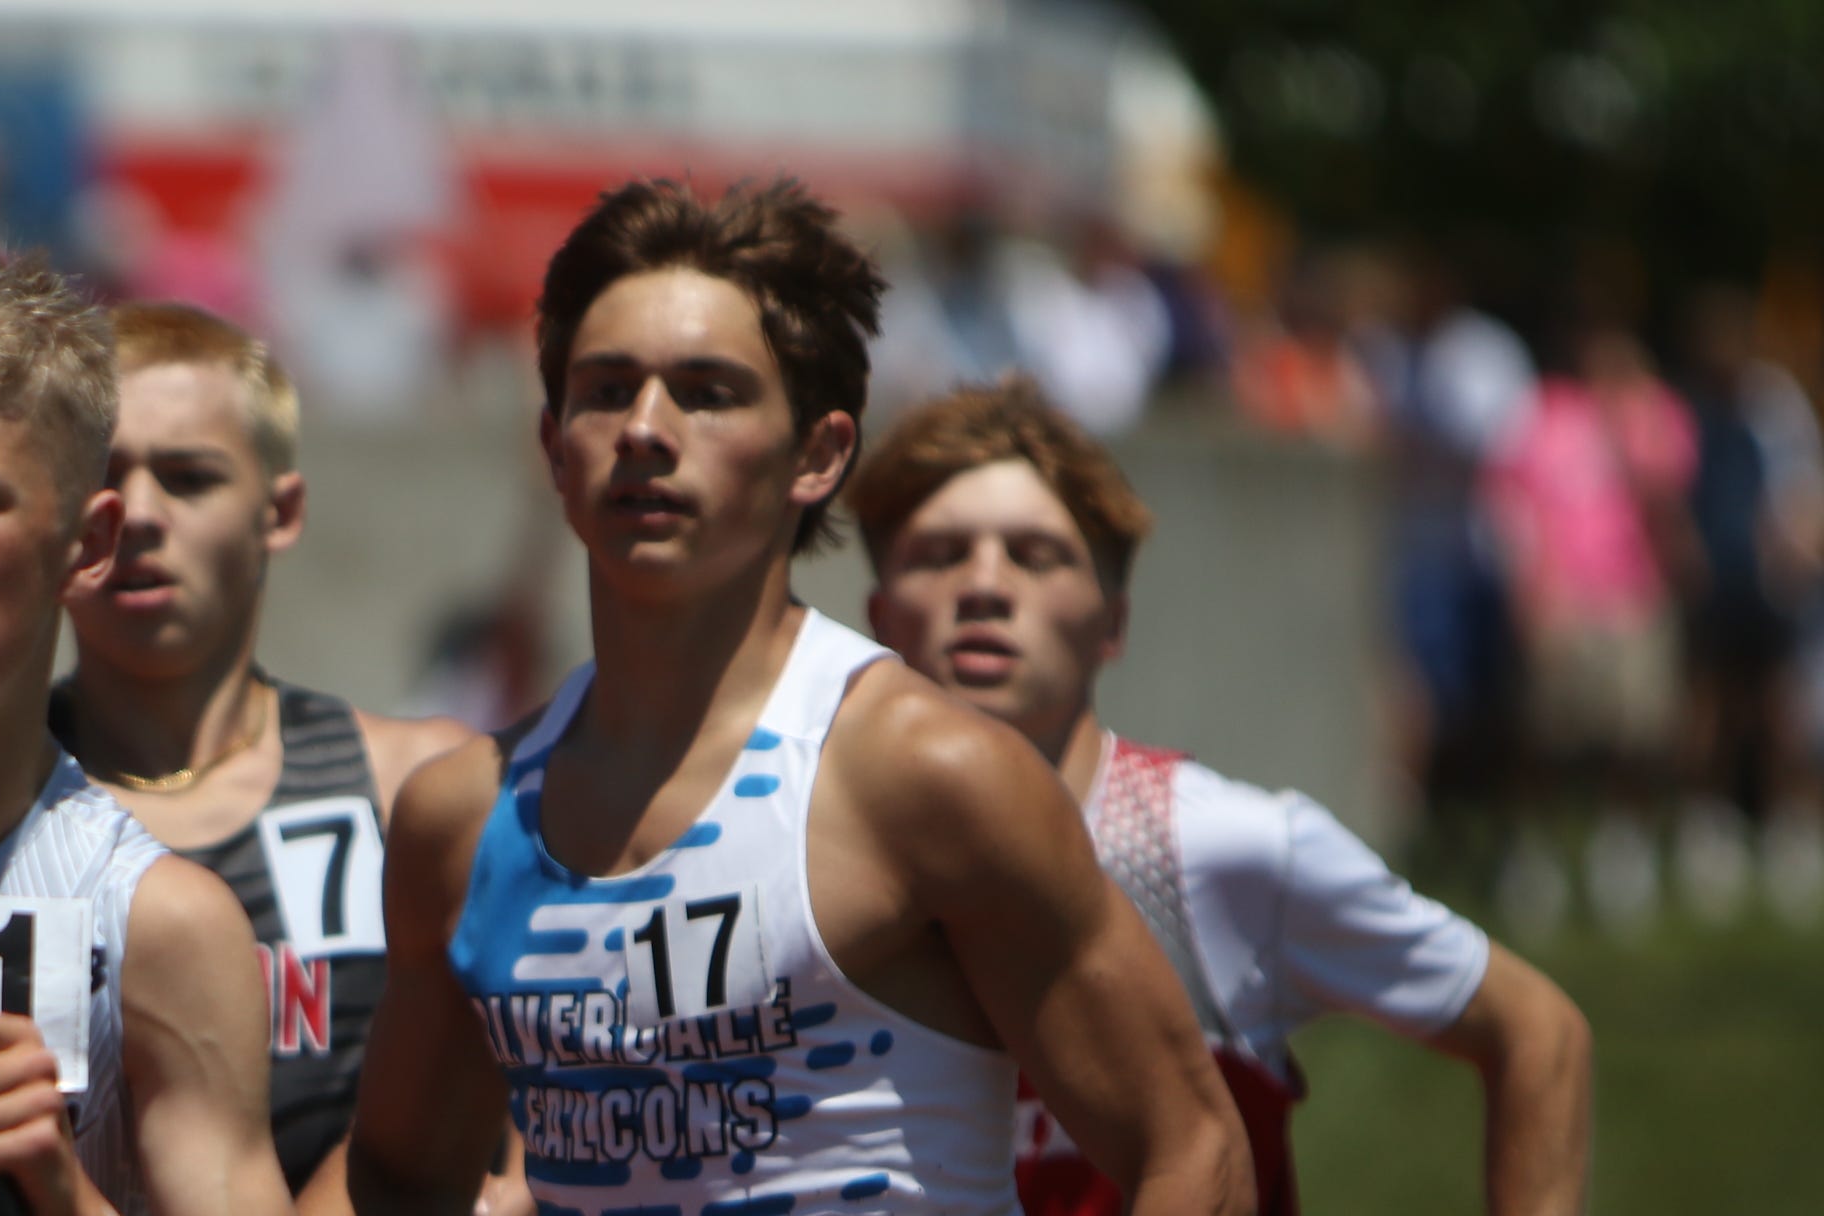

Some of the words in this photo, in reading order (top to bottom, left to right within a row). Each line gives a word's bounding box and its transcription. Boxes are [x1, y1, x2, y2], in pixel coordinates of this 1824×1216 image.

[278, 813, 357, 938] 7
[633, 891, 742, 1019] 17
[472, 976, 798, 1067] IVERDALE
